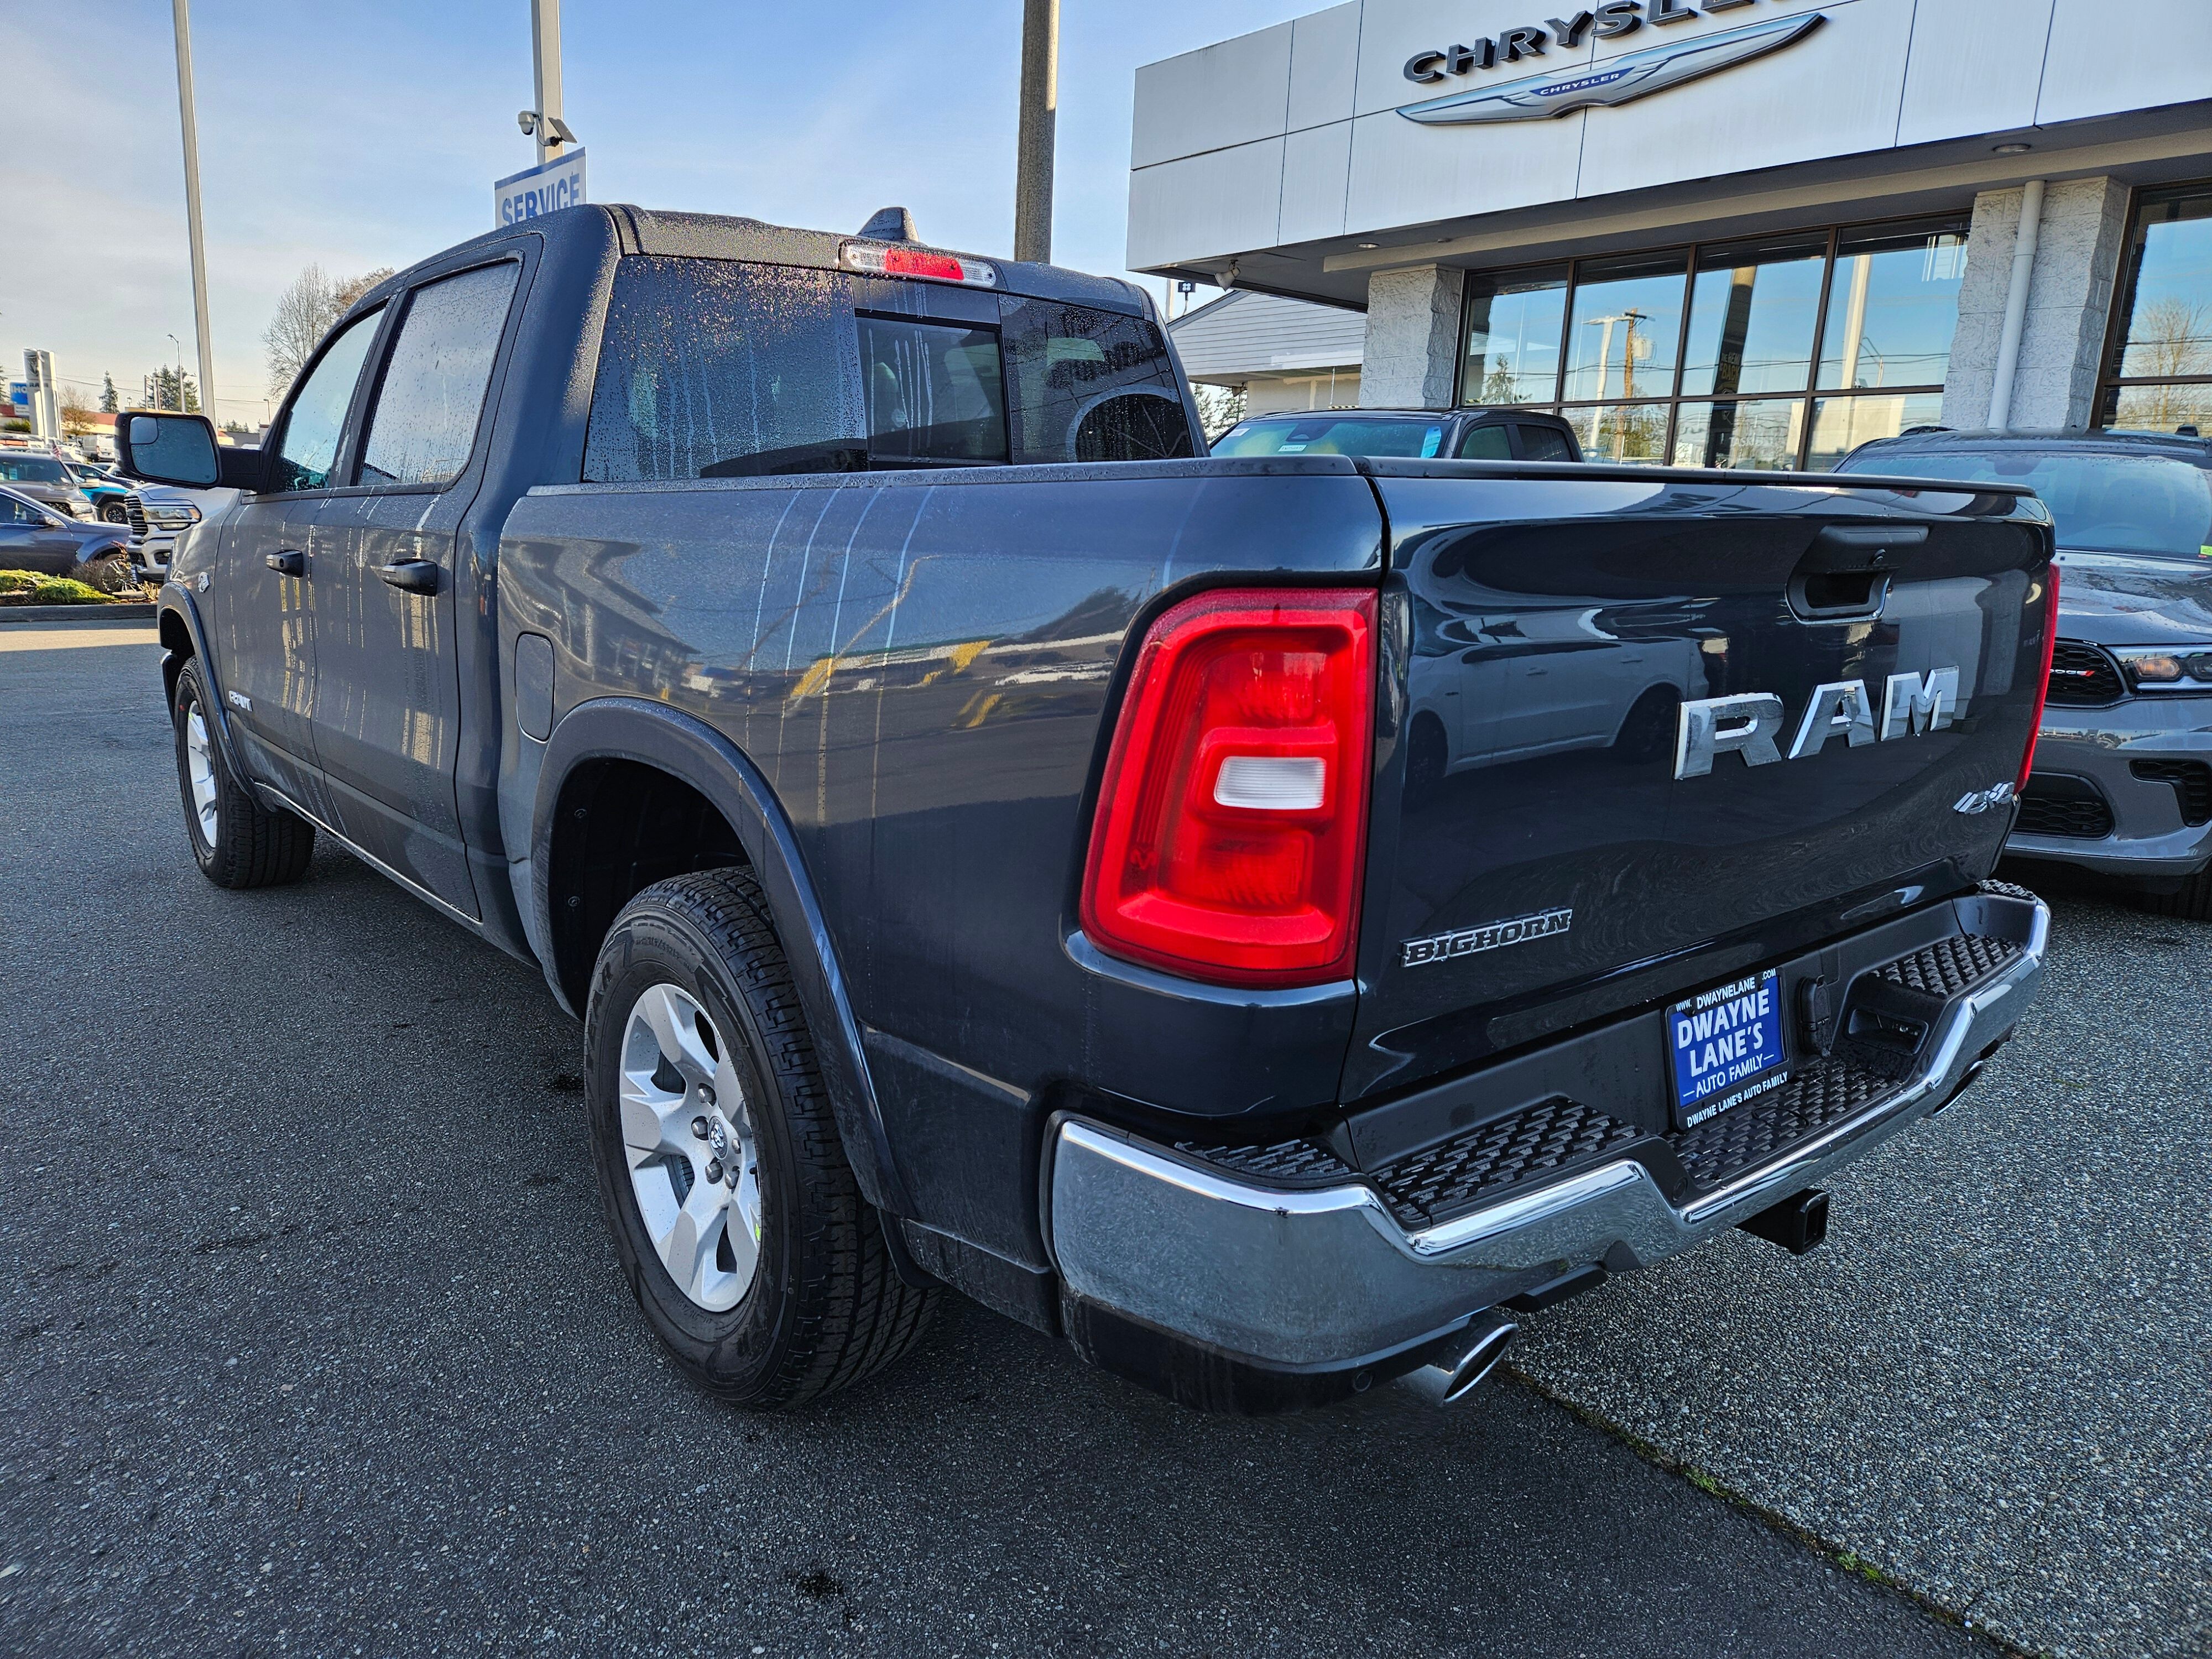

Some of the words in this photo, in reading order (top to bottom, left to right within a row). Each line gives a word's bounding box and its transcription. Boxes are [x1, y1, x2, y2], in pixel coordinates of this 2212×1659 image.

[1404, 0, 1754, 84] CHRYSL
[1540, 72, 1620, 95] CHRYSLER
[502, 173, 580, 224] SERVICE
[228, 690, 253, 712] RAM
[1673, 665, 1959, 780] RAM
[1401, 907, 1573, 967] BIGHORN
[1678, 988, 1770, 1049] DWAYNE
[1697, 977, 1756, 1010] DWAYNELANE
[1690, 1022, 1763, 1077] LANE'S
[1696, 1072, 1726, 1098] AUTO
[1729, 1053, 1764, 1082] FAMILY
[1687, 1104, 1717, 1128] DWAYNE
[1719, 1092, 1743, 1113] LANE'S
[1744, 1083, 1762, 1101] AUTO
[1762, 1071, 1788, 1092] FAMILY
